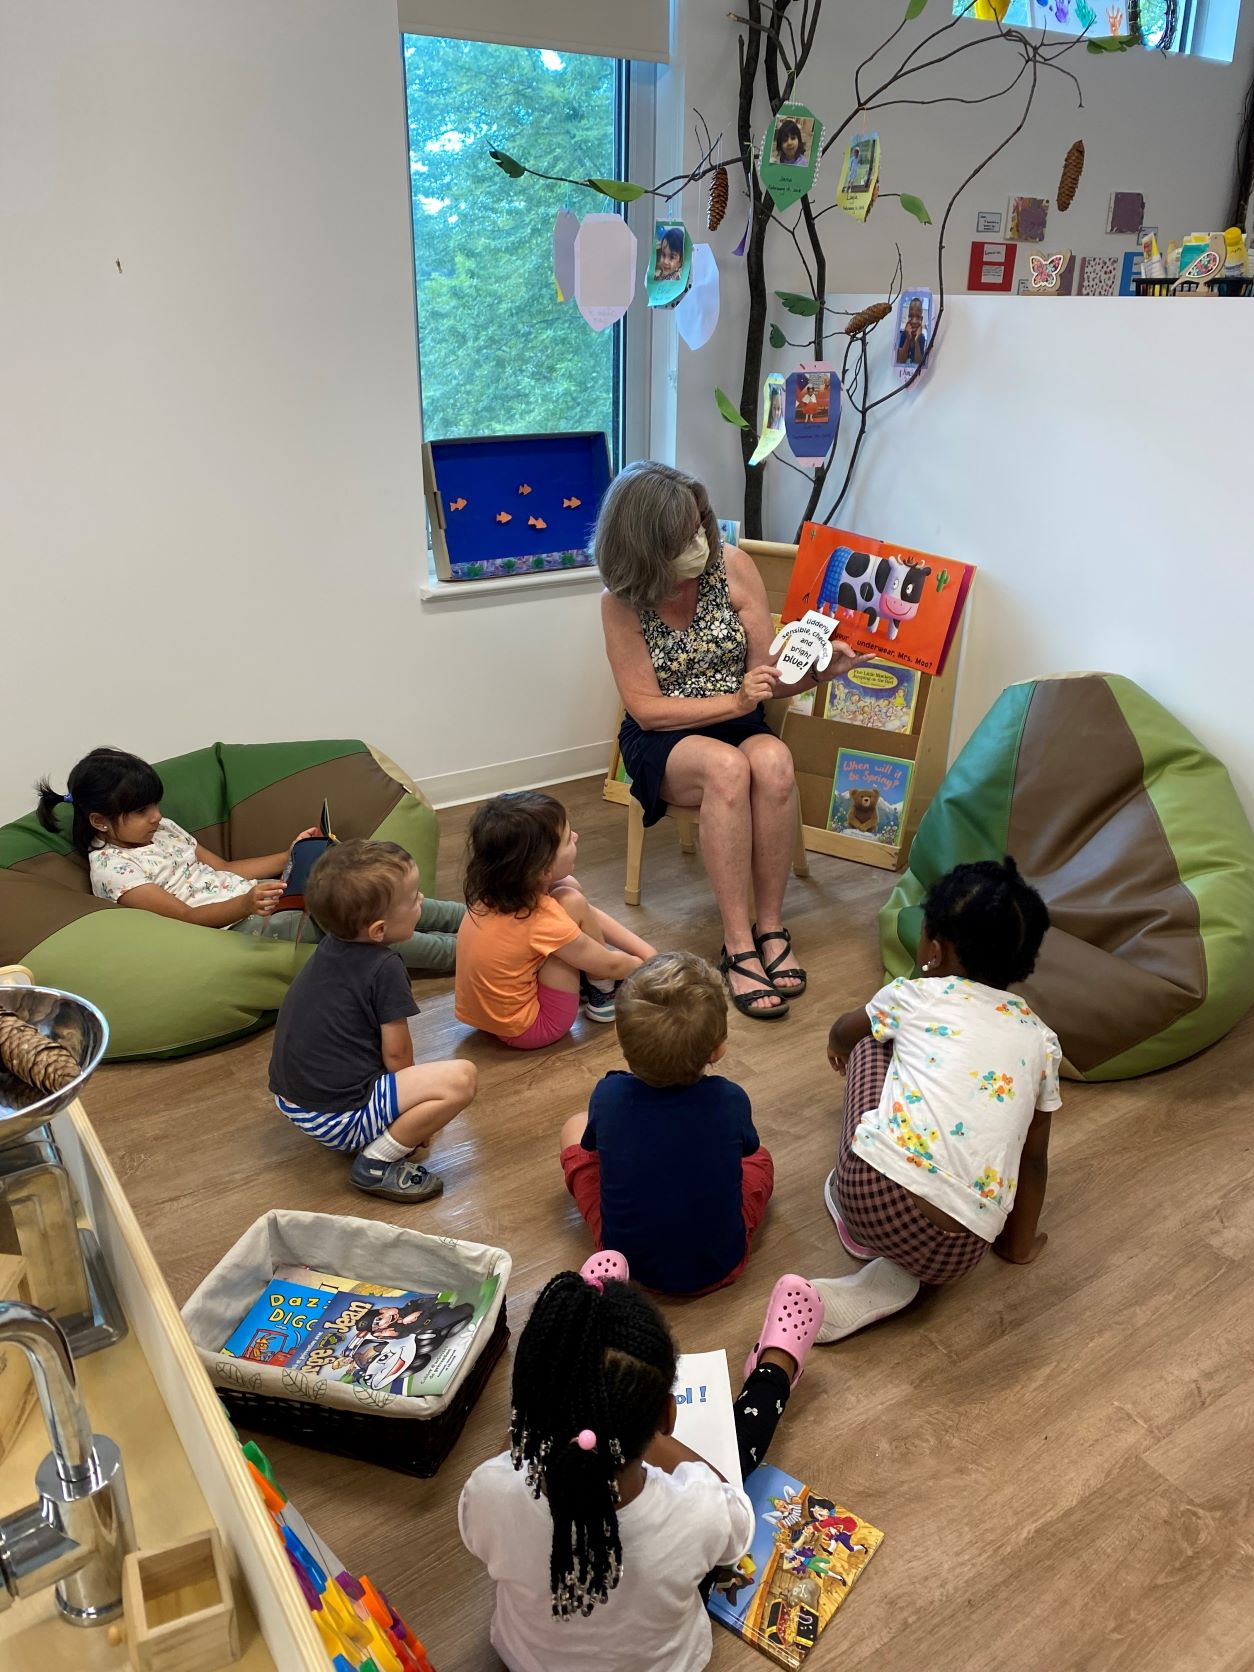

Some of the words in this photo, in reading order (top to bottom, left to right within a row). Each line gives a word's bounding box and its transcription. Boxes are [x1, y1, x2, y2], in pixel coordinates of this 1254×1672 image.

[782, 626, 811, 639] sensible,
[812, 631, 828, 660] checked,
[800, 638, 813, 647] and
[782, 653, 809, 671] blue!
[790, 646, 812, 660] bright
[898, 651, 913, 663] Mrs.
[915, 659, 933, 670] Moo?
[843, 760, 869, 771] When
[875, 764, 893, 774] will
[894, 769, 902, 778] it
[848, 772, 860, 780] be
[863, 770, 900, 790] Spring?
[269, 1293, 331, 1310] Daz
[323, 1301, 374, 1334] Jean
